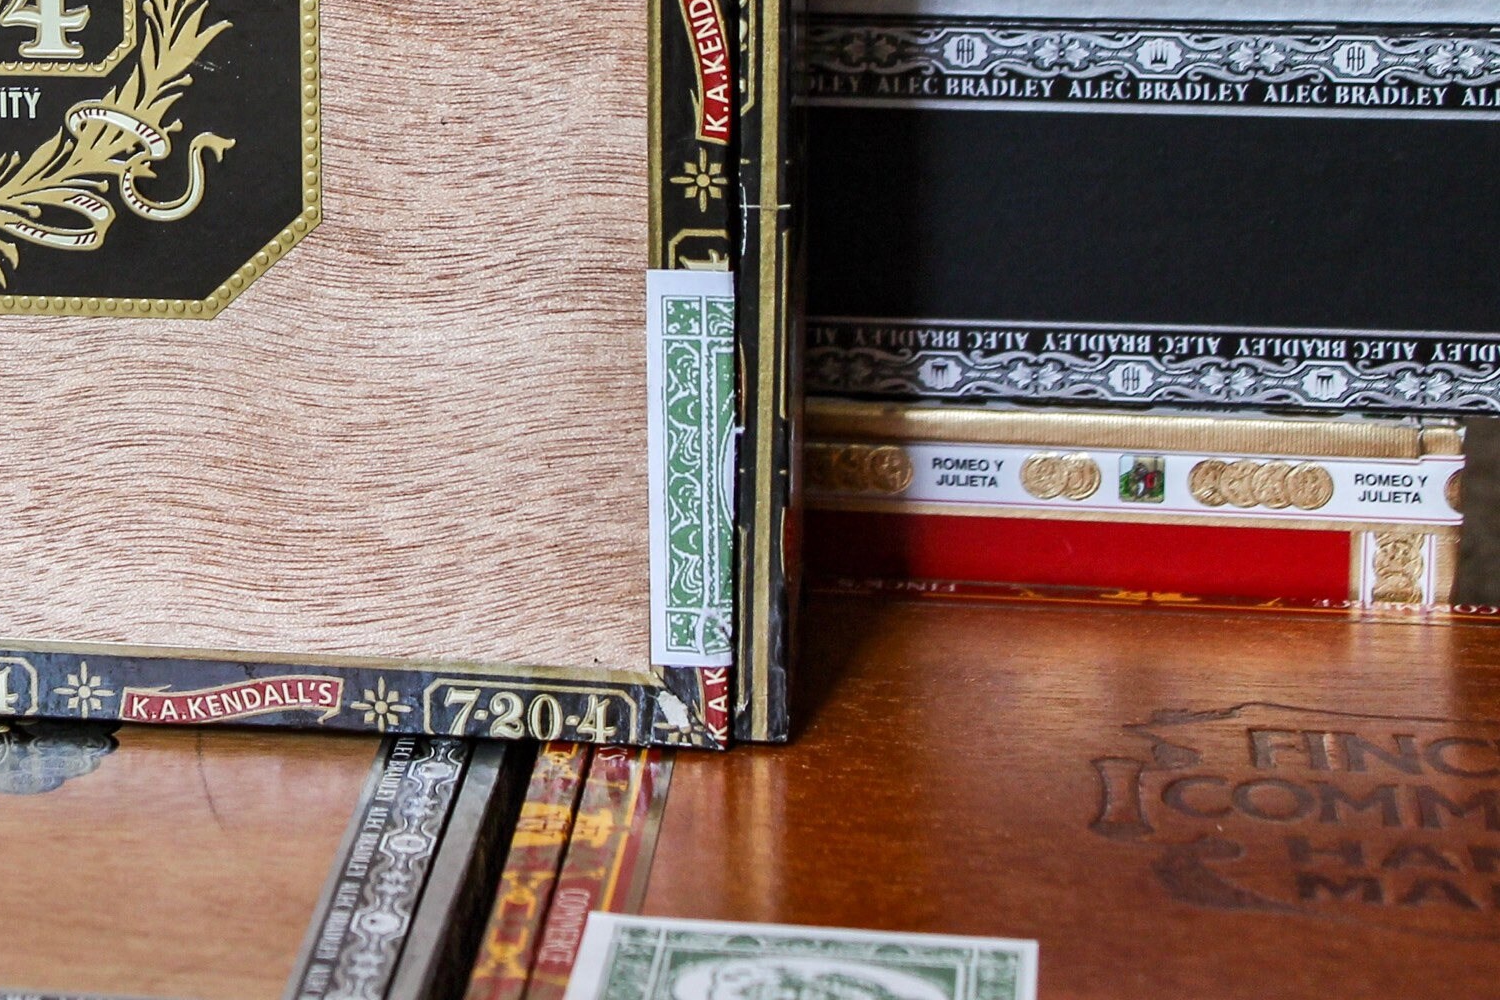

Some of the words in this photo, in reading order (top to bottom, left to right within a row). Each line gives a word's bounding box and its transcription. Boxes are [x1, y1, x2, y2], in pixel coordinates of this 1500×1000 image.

[946, 77, 1054, 98] BRADLEY
[1067, 79, 1132, 100] ALEC
[1138, 81, 1249, 102] BRADLEY
[1264, 83, 1328, 104] ALEC
[1334, 85, 1448, 107] BRADLEY
[855, 328, 960, 349] BRADLEY
[968, 330, 1030, 350] ALEC
[1042, 332, 1151, 353] BRADLEY
[1158, 336, 1223, 356] ALEC
[1236, 336, 1348, 359] BRADLEY
[1354, 340, 1420, 361] ALEC
[932, 456, 988, 472] ROMEO
[993, 458, 1005, 473] Y
[936, 473, 999, 488] JULIETA
[1354, 473, 1413, 489] ROMEO
[1418, 474, 1429, 488] Y
[1357, 489, 1423, 505] JULIETA
[131, 681, 334, 720] K.A.KENDALL'S
[444, 686, 617, 743] 7-20-4
